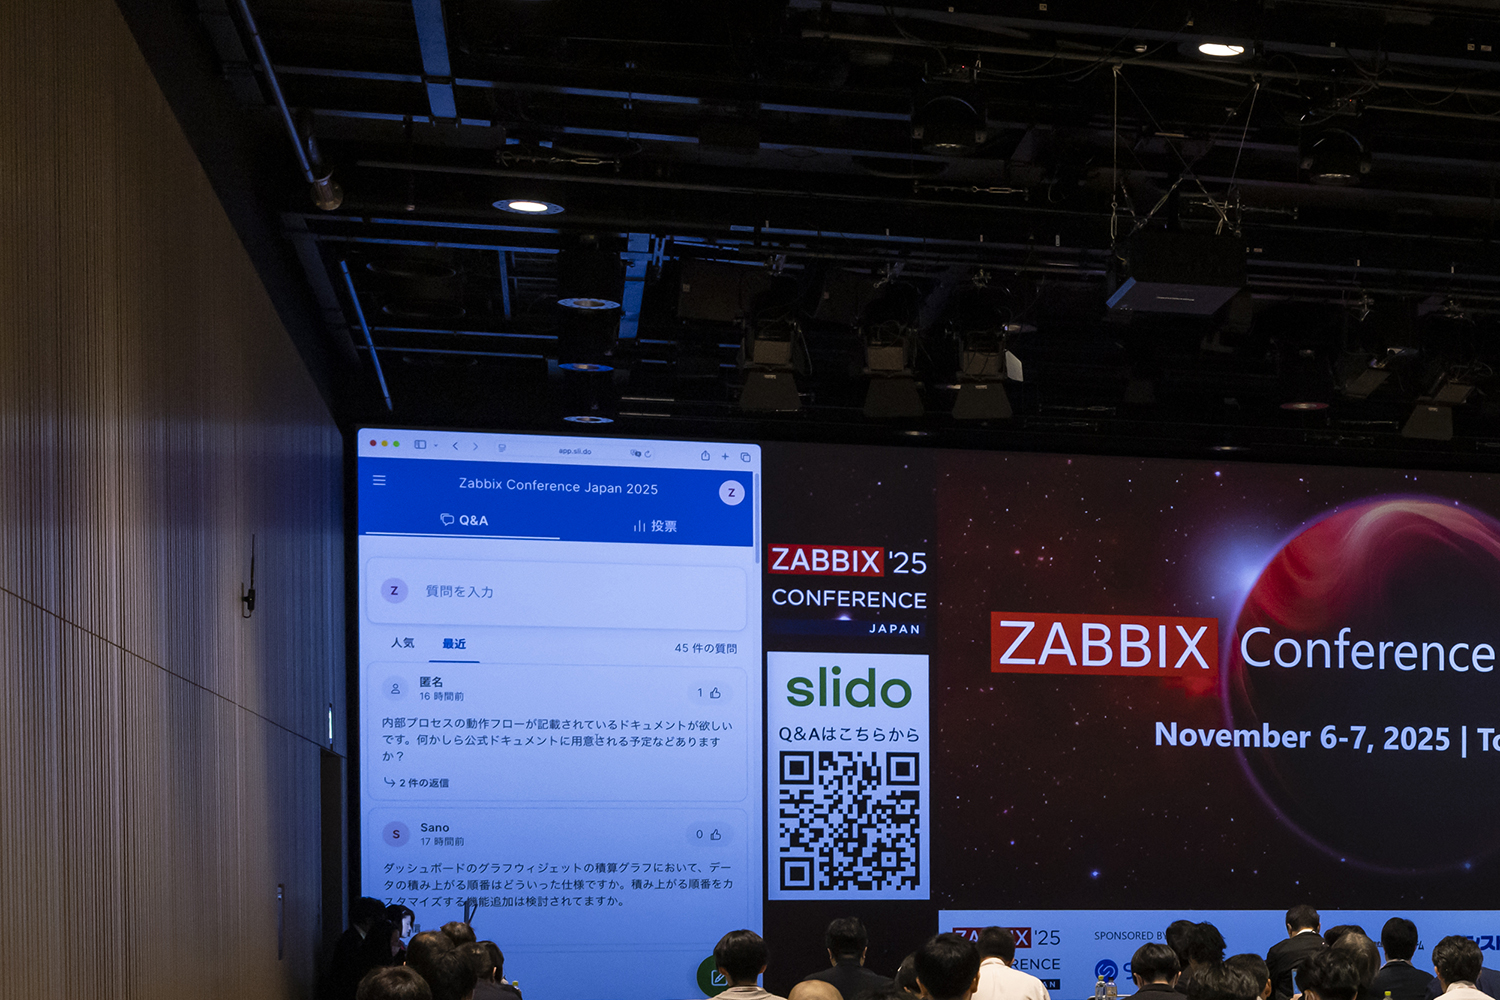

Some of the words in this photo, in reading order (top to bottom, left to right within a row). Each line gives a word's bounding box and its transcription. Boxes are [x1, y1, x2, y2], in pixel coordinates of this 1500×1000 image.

[559, 446, 592, 456] app.sli.do
[459, 477, 502, 490] Zabbix
[506, 479, 580, 492] Conference
[584, 481, 622, 495] Japan
[626, 483, 659, 495] 2025
[728, 488, 736, 497] Z
[459, 514, 489, 527] Q&A
[650, 520, 677, 533] 投票
[771, 547, 881, 573] ZABBIX
[888, 552, 927, 575] '25
[390, 586, 398, 596] Z
[425, 584, 494, 599] 質問を入力
[772, 589, 927, 609] CONFERENCE
[869, 623, 921, 634] JAPAN
[391, 637, 415, 649] 人気
[442, 638, 467, 650] 最近
[675, 643, 688, 653] 45
[693, 642, 738, 655] 件の質問
[999, 620, 1210, 669] ZABBIX
[1239, 626, 1496, 672] Conference
[419, 676, 443, 689] 匿名
[787, 666, 913, 709] slido
[420, 692, 430, 701] 16
[433, 691, 464, 702] 時間前
[697, 687, 703, 697] 1
[381, 717, 733, 732] 内部プロセスの動作フローが記載されているドキュメントが欲しい
[778, 725, 920, 743] Q&Aはこちらから
[1154, 721, 1311, 748] November
[1320, 724, 1376, 756] 6-7,
[1383, 726, 1451, 752] 2025
[382, 733, 720, 749] です。何かしら公式ドキュメントに用意される予定などあります
[400, 778, 406, 788] 2
[408, 777, 449, 789] 件の返信
[392, 829, 400, 839] S
[420, 822, 450, 833] Sano
[420, 837, 431, 846] 17
[434, 836, 464, 847] 時間前
[383, 861, 732, 875] ダッシュボードのグラフウィジェットの積算グラフにおいて、デー
[384, 879, 733, 892] タの積み上がる順番はどういった仕様ですか。積み上がる順番をカ
[1034, 929, 1061, 946] '25
[1094, 931, 1154, 940] SPONSORED
[1156, 931, 1168, 940] BY
